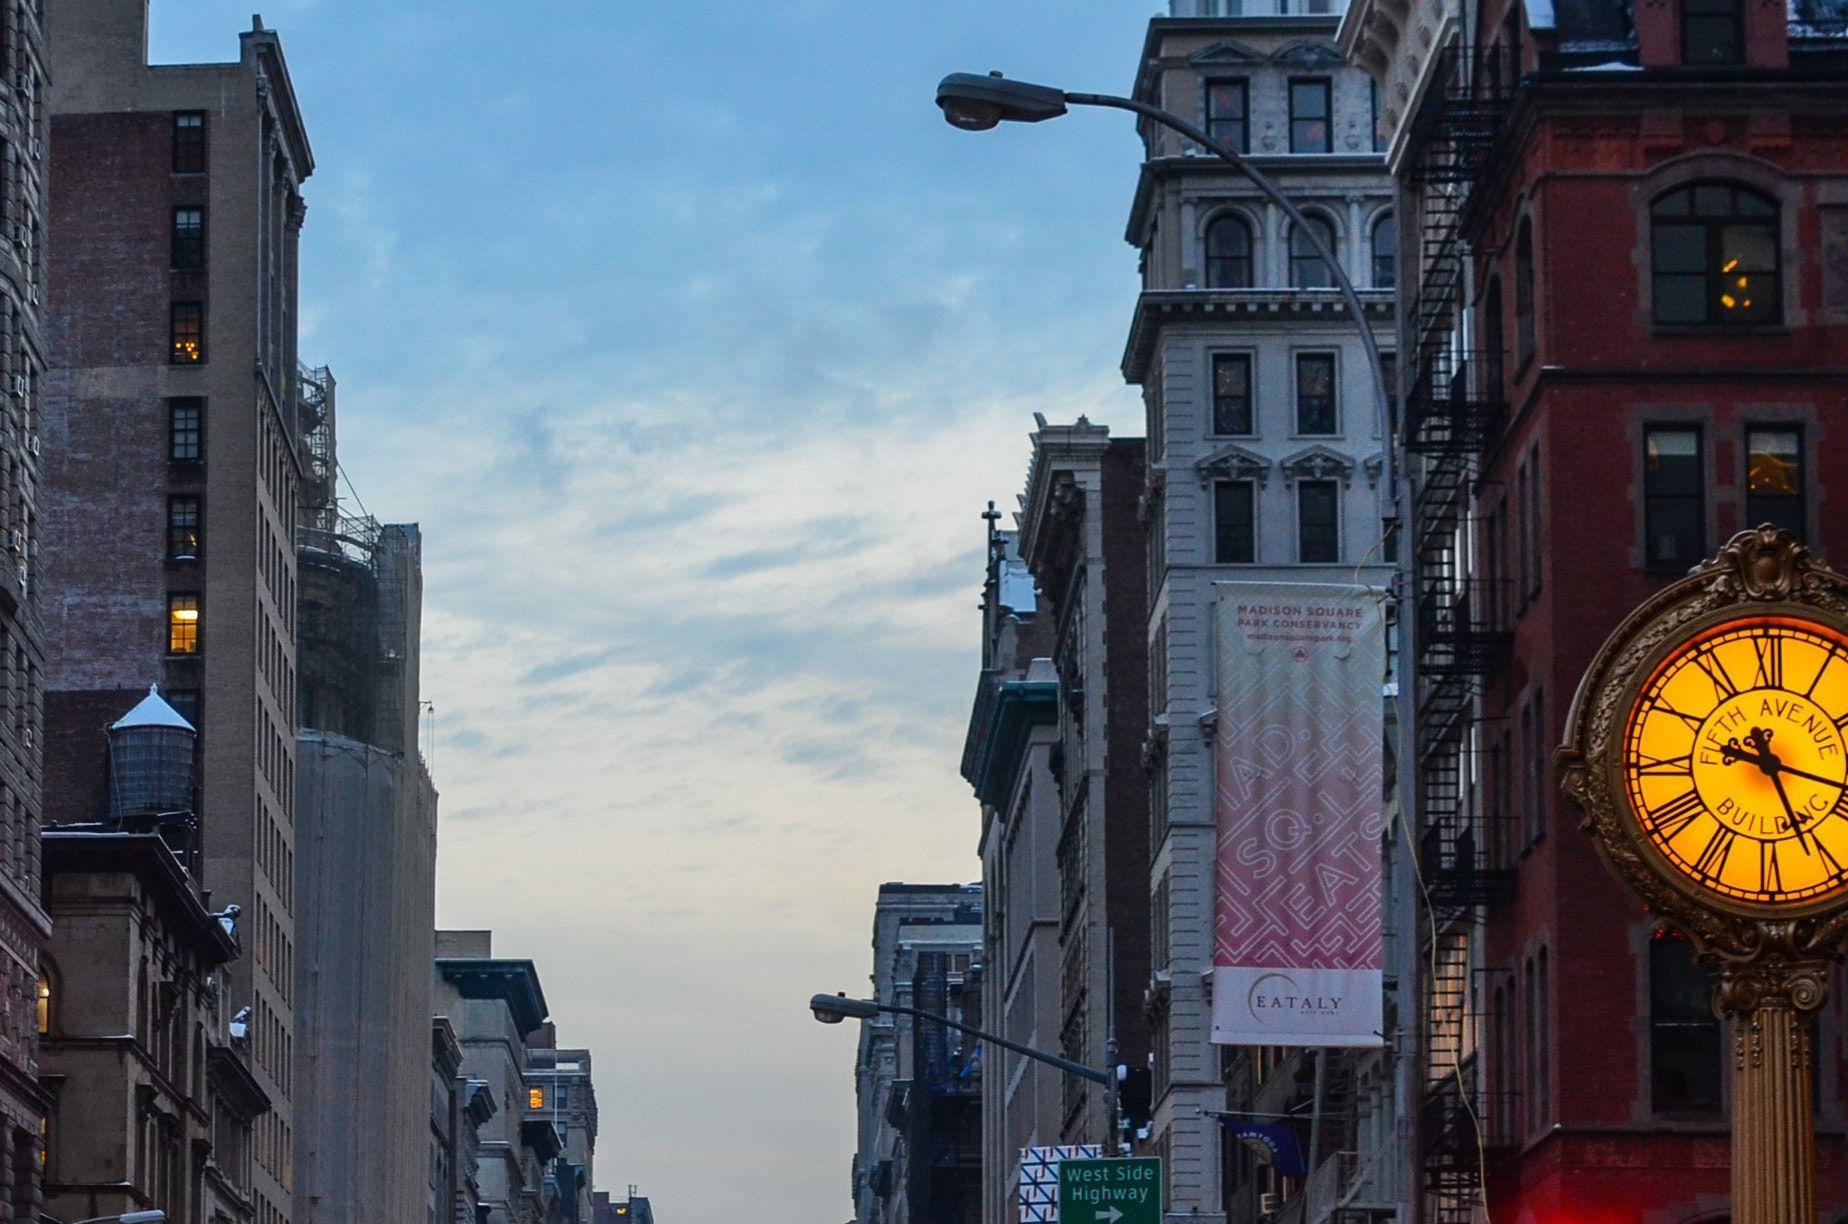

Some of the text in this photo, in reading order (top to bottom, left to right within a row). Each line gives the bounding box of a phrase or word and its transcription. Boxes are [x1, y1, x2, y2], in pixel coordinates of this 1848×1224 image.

[1237, 605, 1363, 618] MADISON SQUARE
[1237, 619, 1361, 630] PARK CONSERVANCY
[1699, 698, 1839, 767] FIFTH AVENUE
[1716, 793, 1830, 835] BUILDNG
[1256, 996, 1342, 1010] EATALY
[1067, 1165, 1154, 1182] West Side
[1072, 1186, 1149, 1204] Highway
